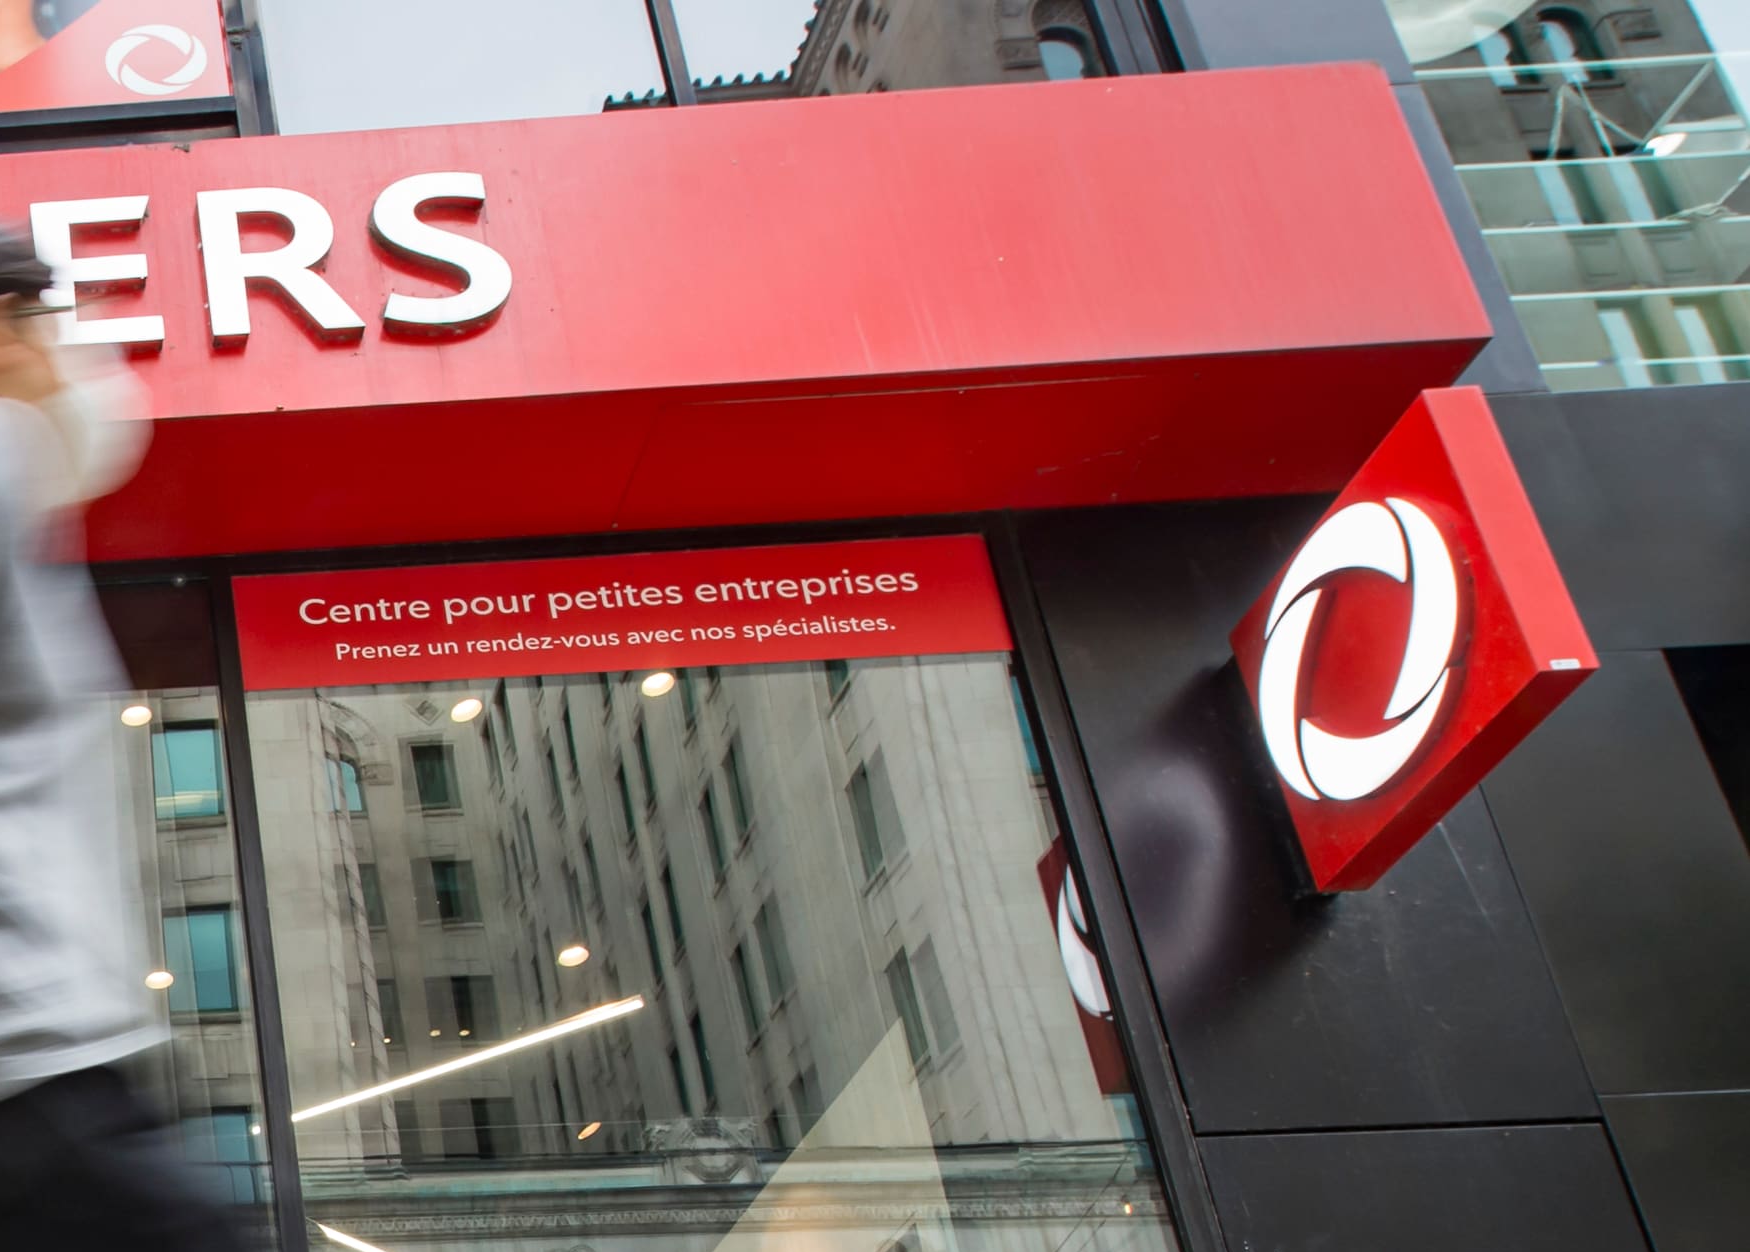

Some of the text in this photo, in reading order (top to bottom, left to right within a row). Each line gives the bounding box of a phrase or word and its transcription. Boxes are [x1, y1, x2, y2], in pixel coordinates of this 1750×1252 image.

[299, 569, 919, 625] Centre pour petites entreprises
[335, 616, 896, 660] Prenez un rendez-vous avec nos spécialistes.
